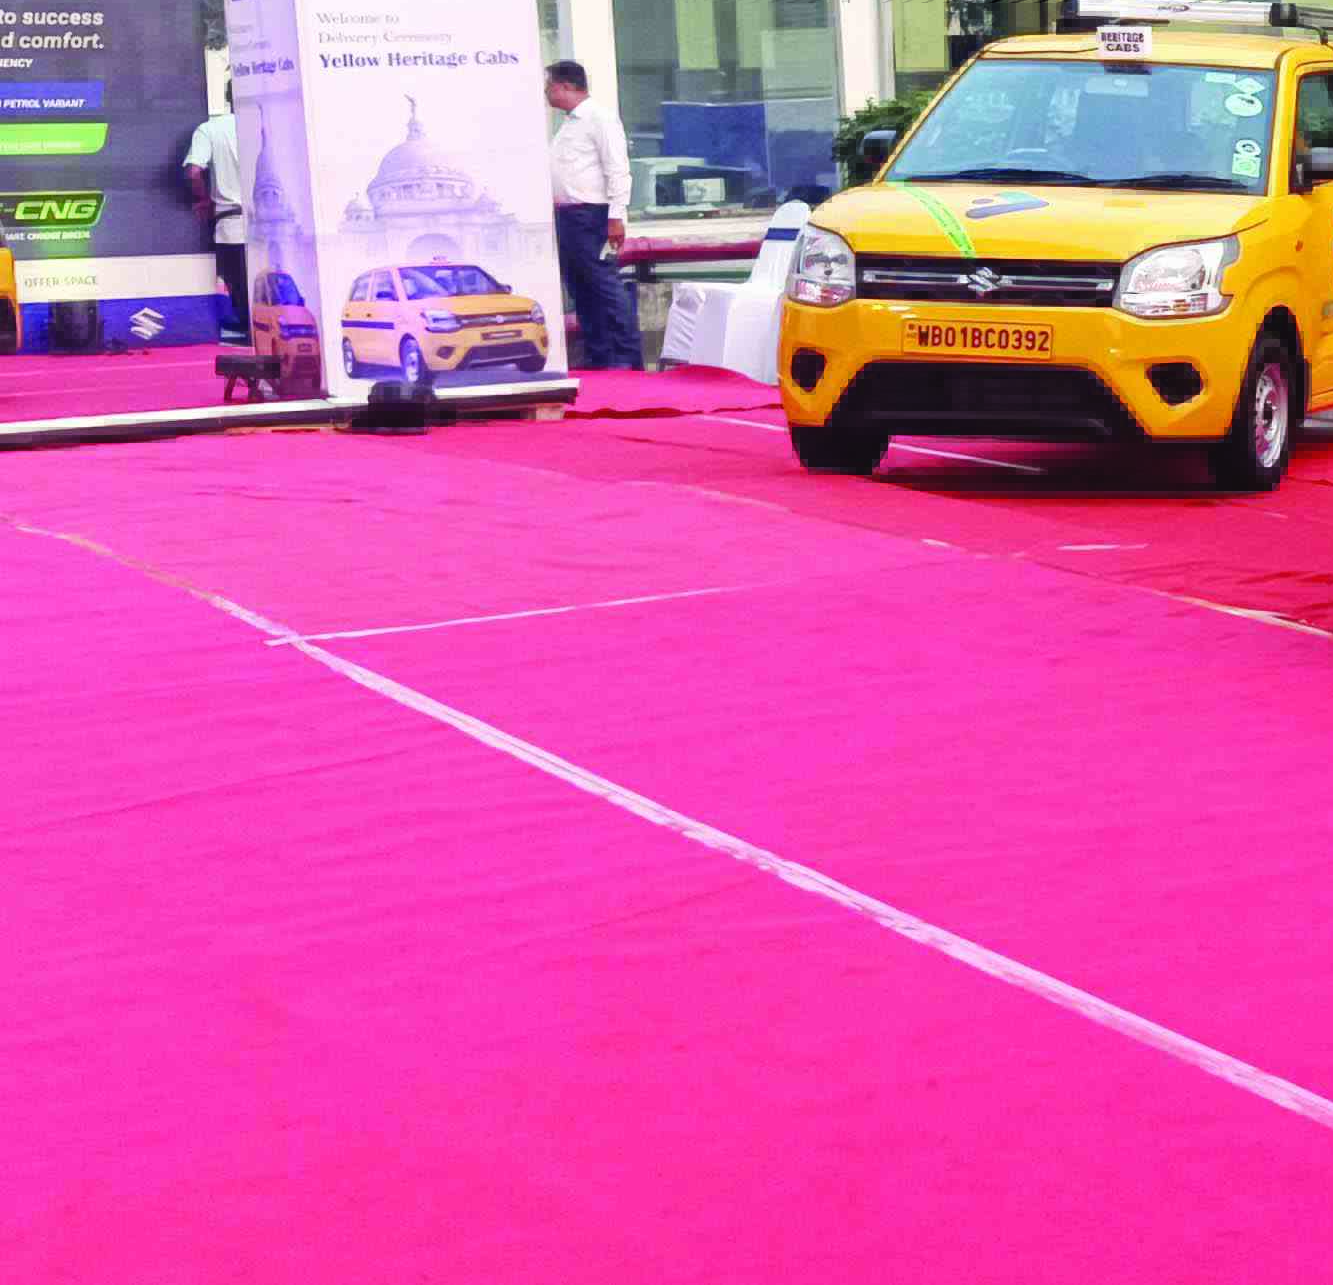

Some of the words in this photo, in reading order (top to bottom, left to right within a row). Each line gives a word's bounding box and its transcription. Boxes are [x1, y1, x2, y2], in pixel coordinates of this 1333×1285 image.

[22, 11, 104, 26] success
[316, 12, 381, 25] Welcome
[385, 14, 401, 25] to
[19, 31, 105, 50] comfort.
[318, 31, 378, 48] Delivery
[1105, 43, 1141, 53] CABS
[319, 52, 382, 70] Yellow
[387, 50, 468, 70] Heritage
[474, 49, 521, 66] Cabs
[4, 98, 41, 108] PETROL
[43, 98, 86, 108] VARIANT
[24, 275, 60, 288] OFFER
[63, 274, 99, 287] SPACE
[917, 324, 1050, 352] WB01BC0392
